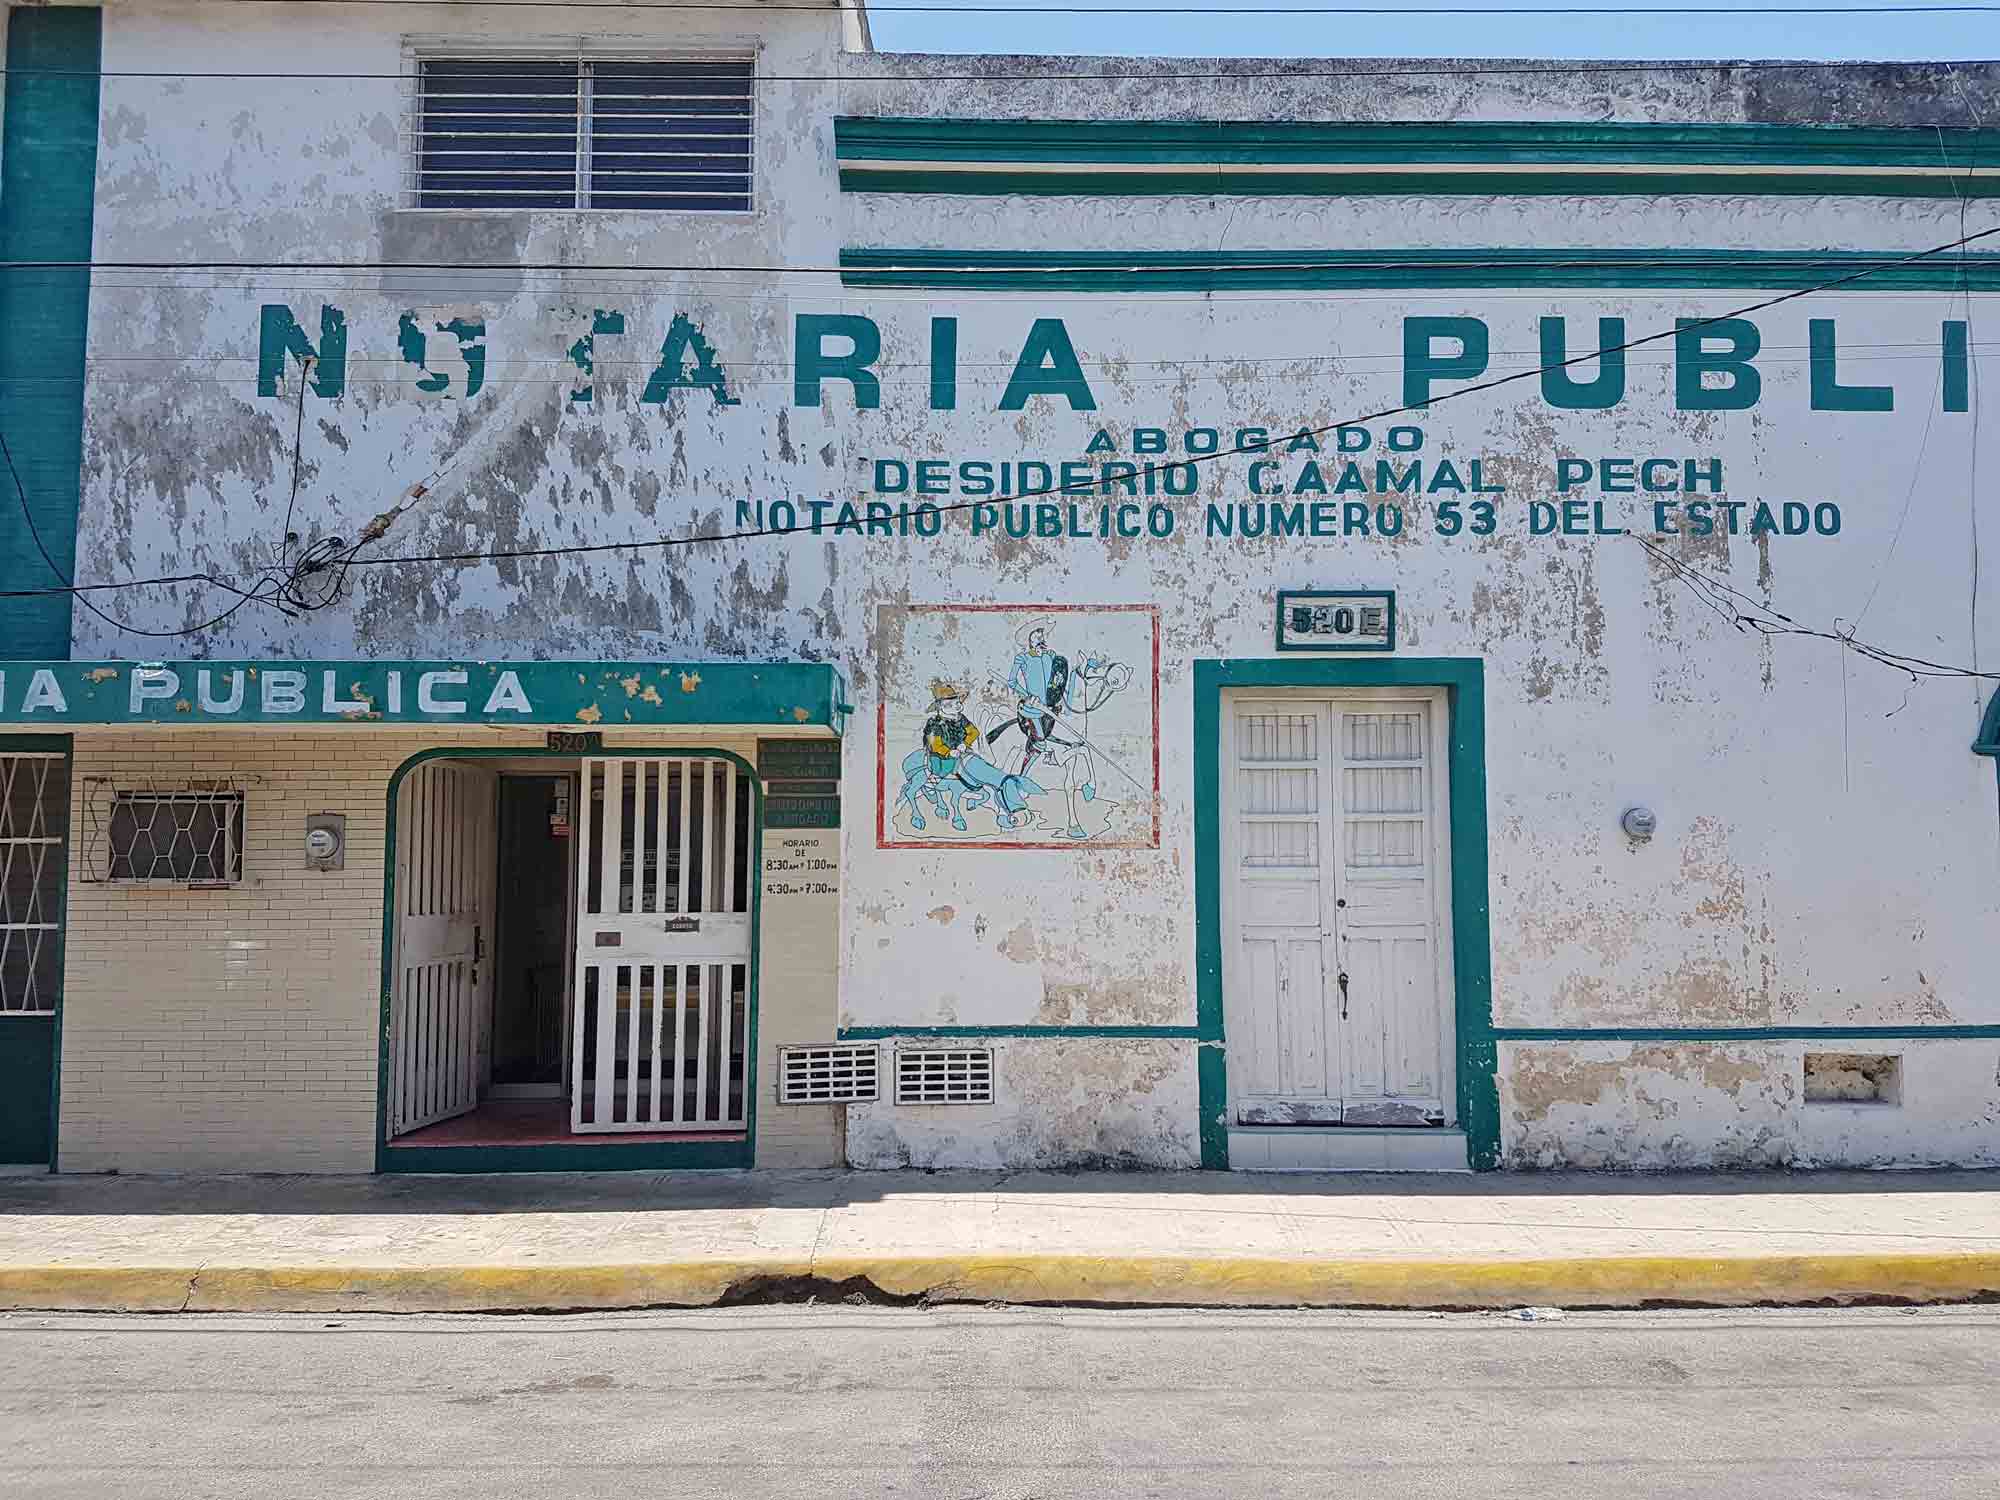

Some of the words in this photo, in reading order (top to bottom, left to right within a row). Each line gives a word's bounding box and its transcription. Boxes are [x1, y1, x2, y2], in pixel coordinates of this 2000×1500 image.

[1402, 316, 1969, 413] PUBLI
[1085, 425, 1424, 454] ABOGADO
[873, 459, 1199, 496] DESIDERIO
[1247, 458, 1506, 495] CAAMAL
[1557, 458, 1723, 493] PECH
[735, 499, 942, 537] NOTARIO
[972, 503, 1175, 538] PUBLICO
[1205, 501, 1403, 538] NUMERO
[1436, 501, 1497, 537] 53
[1529, 500, 1623, 536] DEL
[1653, 501, 1842, 536] ESTADO
[128, 669, 532, 714] PUBLICA
[782, 839, 820, 848] HORARIO
[795, 849, 806, 857] DE
